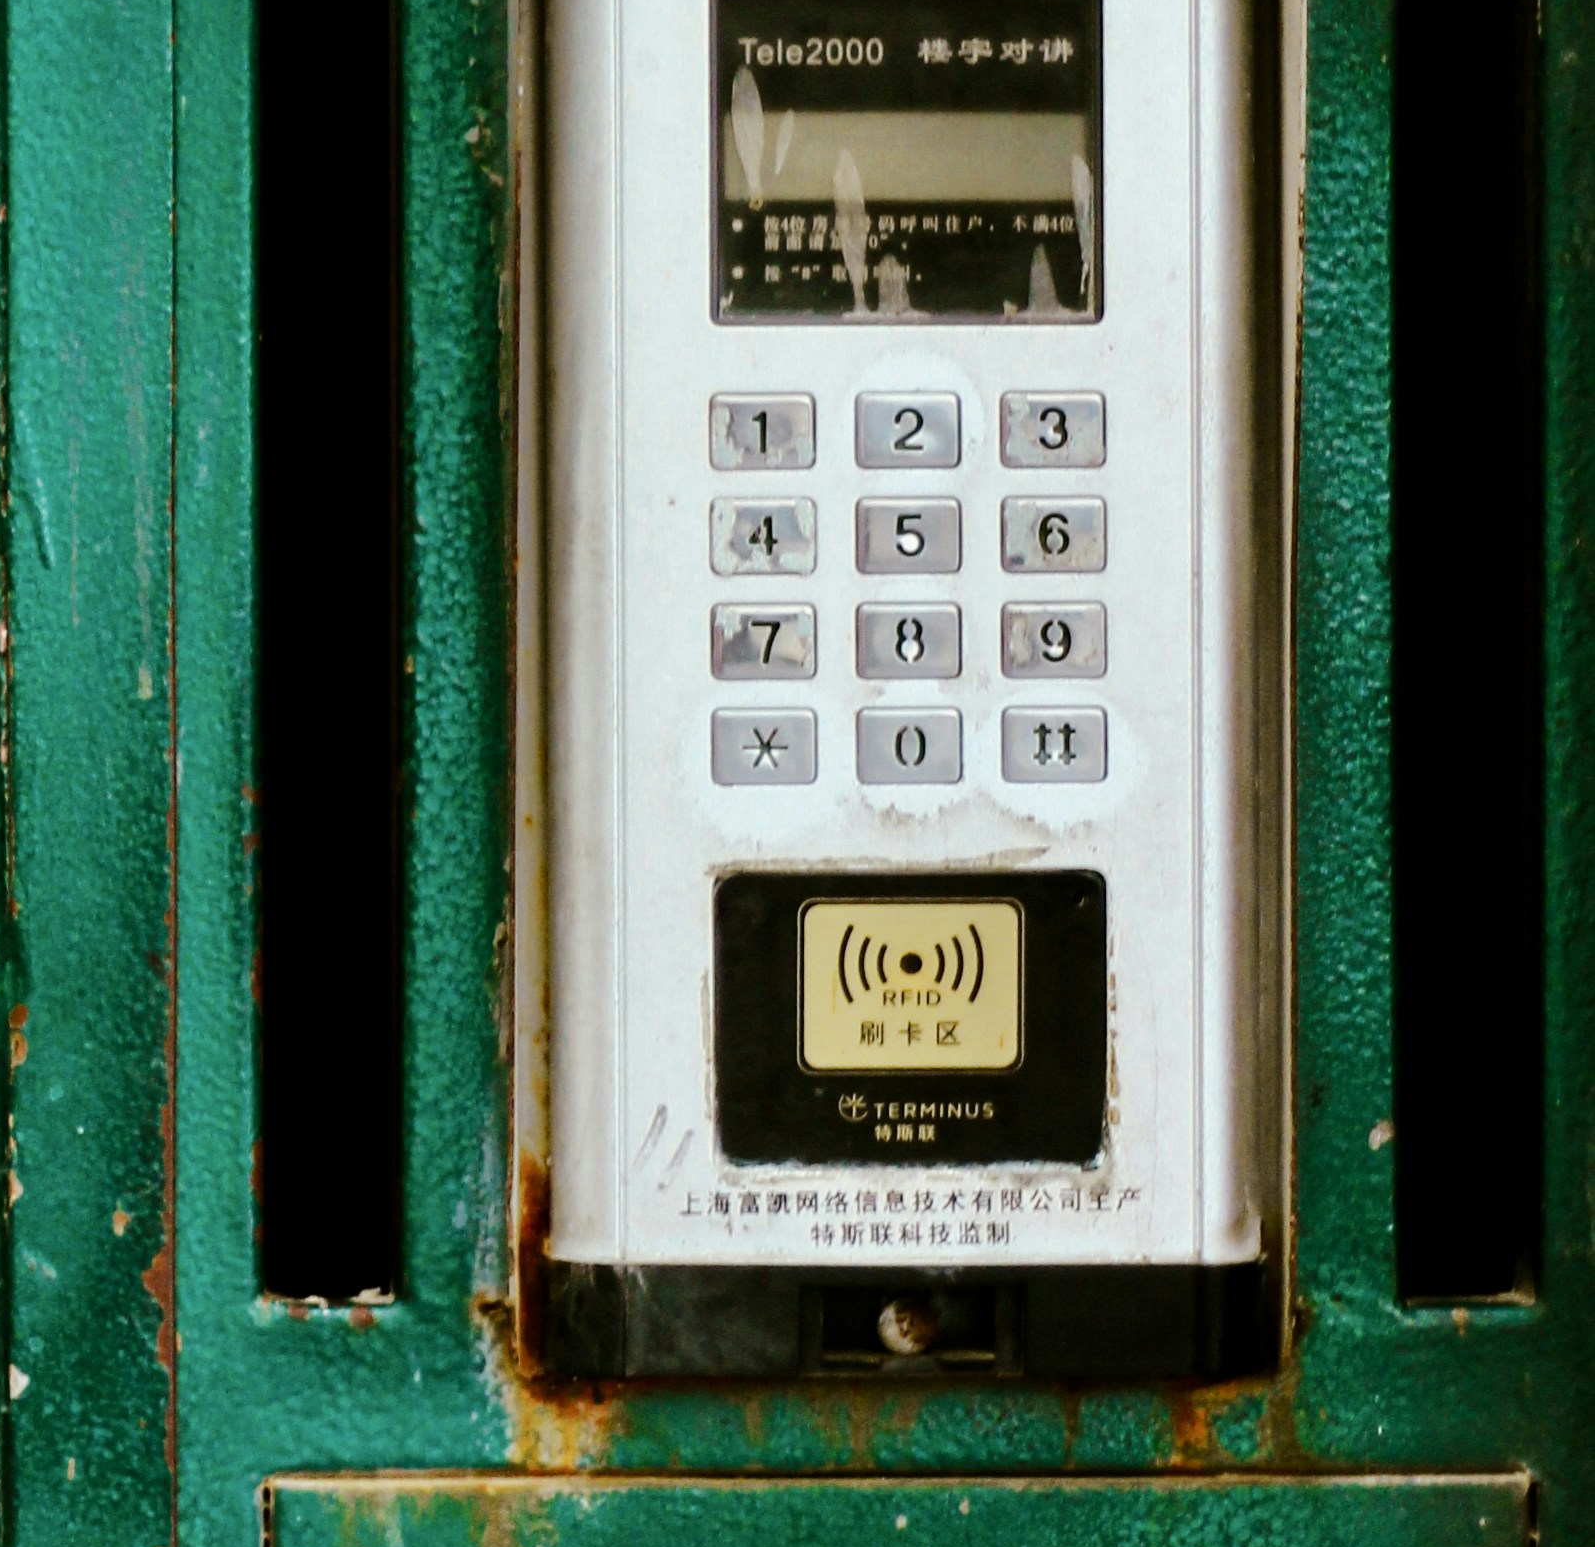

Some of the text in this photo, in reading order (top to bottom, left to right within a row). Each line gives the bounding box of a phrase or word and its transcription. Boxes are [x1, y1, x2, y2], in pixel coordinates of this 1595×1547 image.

[738, 37, 1074, 66] Tele2000 楼宇对讲
[752, 408, 1068, 453] 1 2 3
[749, 513, 1070, 557] 4 5 6
[751, 618, 1072, 664] 7 8 9
[895, 726, 926, 767] 0
[882, 990, 941, 1006] RFID
[860, 1020, 961, 1046] 刷卡区
[874, 1102, 994, 1119] TERMINUS
[874, 1124, 935, 1142] 特斯联
[811, 1221, 1010, 1247] 特斯联科技监制
